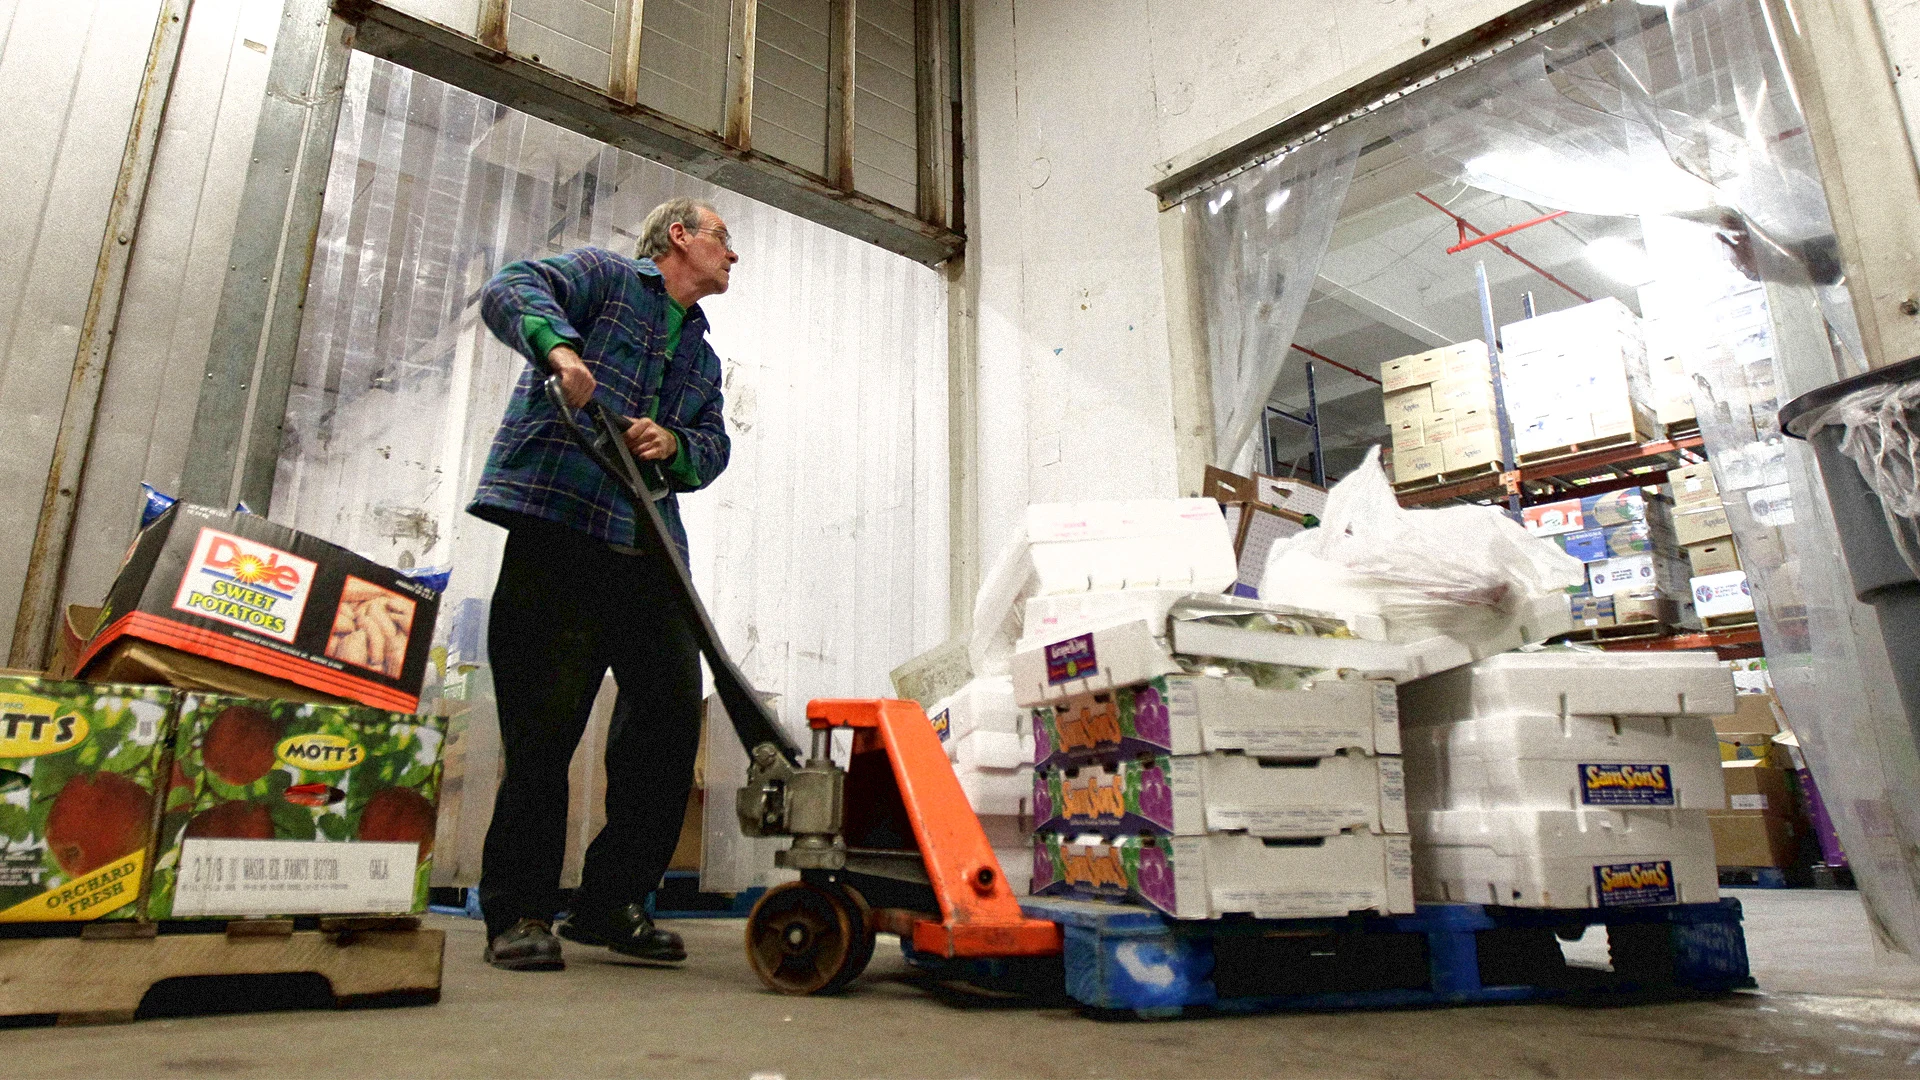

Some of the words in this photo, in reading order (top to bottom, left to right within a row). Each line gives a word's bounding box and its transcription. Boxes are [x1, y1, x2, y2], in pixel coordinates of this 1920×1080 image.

[204, 535, 300, 592] Dole
[186, 590, 287, 634] POTATOES
[211, 579, 278, 611] SWEET
[46, 861, 136, 909] ORCHARD
[67, 881, 125, 916] FRESH
